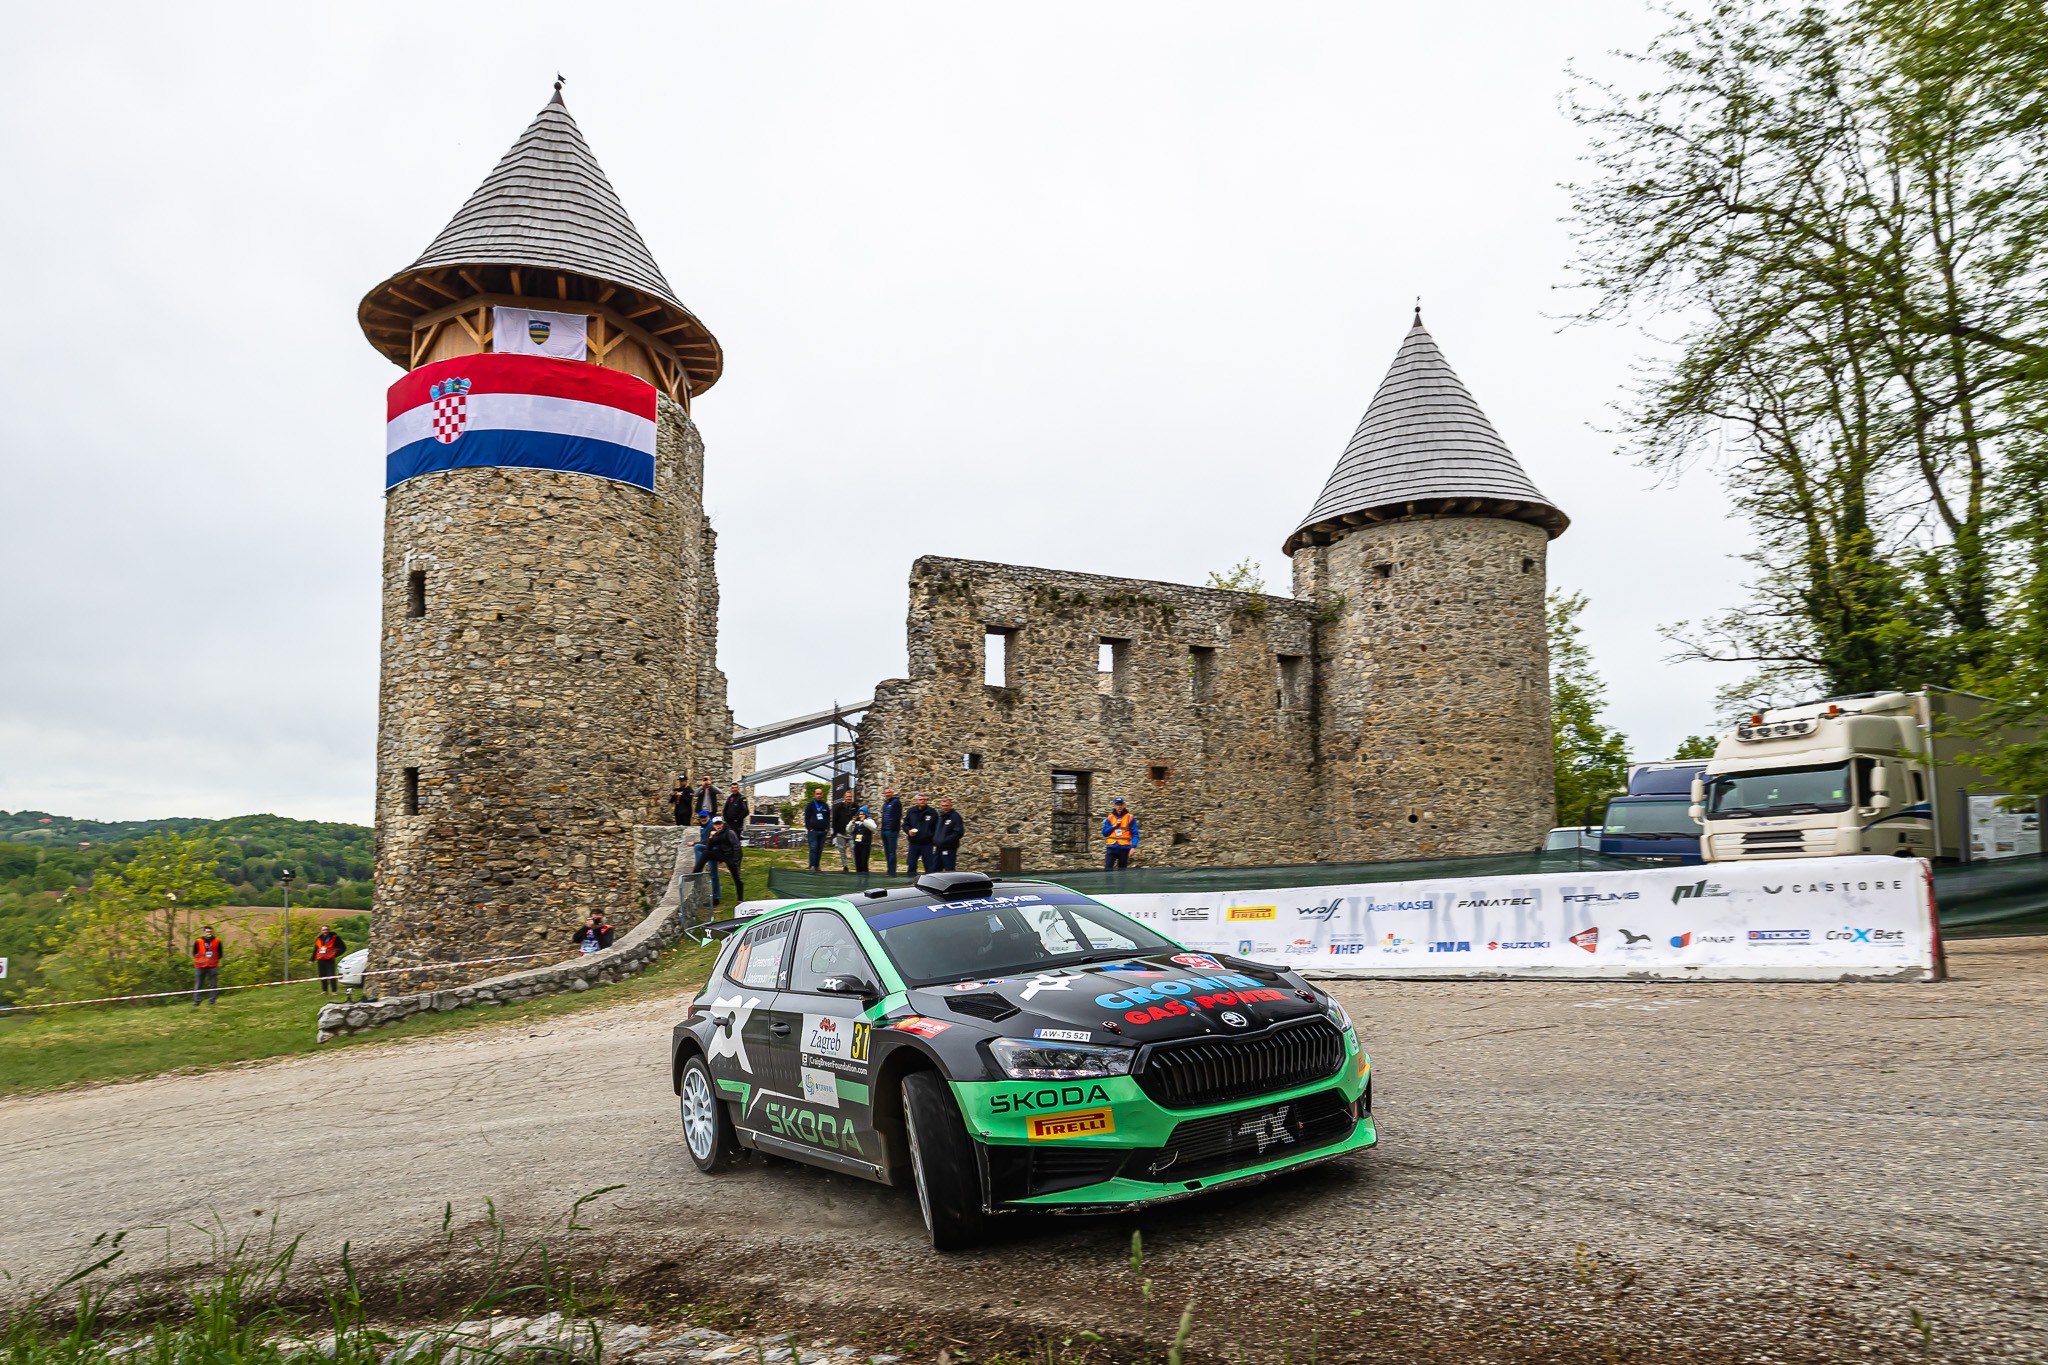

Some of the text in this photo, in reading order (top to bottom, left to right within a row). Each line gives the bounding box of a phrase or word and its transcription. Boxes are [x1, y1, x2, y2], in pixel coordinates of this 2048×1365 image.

[1792, 880, 1902, 893] CASTORE
[927, 895, 1042, 912] FORUM8
[1457, 897, 1534, 908] FANATEC
[1172, 907, 1209, 916] WRC
[1231, 908, 1272, 919] PIRELLI
[1501, 941, 1550, 949] SUZUKI
[1695, 936, 1736, 944] JANAF
[1341, 944, 1364, 954] HEP
[1094, 973, 1266, 1010] CROWN
[1124, 989, 1290, 1025] GAS POWER
[852, 1022, 870, 1060] 31
[1042, 1030, 1089, 1040] AW-TS 521
[810, 1030, 841, 1055] Zagreb
[809, 1056, 868, 1076] CraigBreenFoundation.com
[1034, 1112, 1106, 1137] PIRELLI
